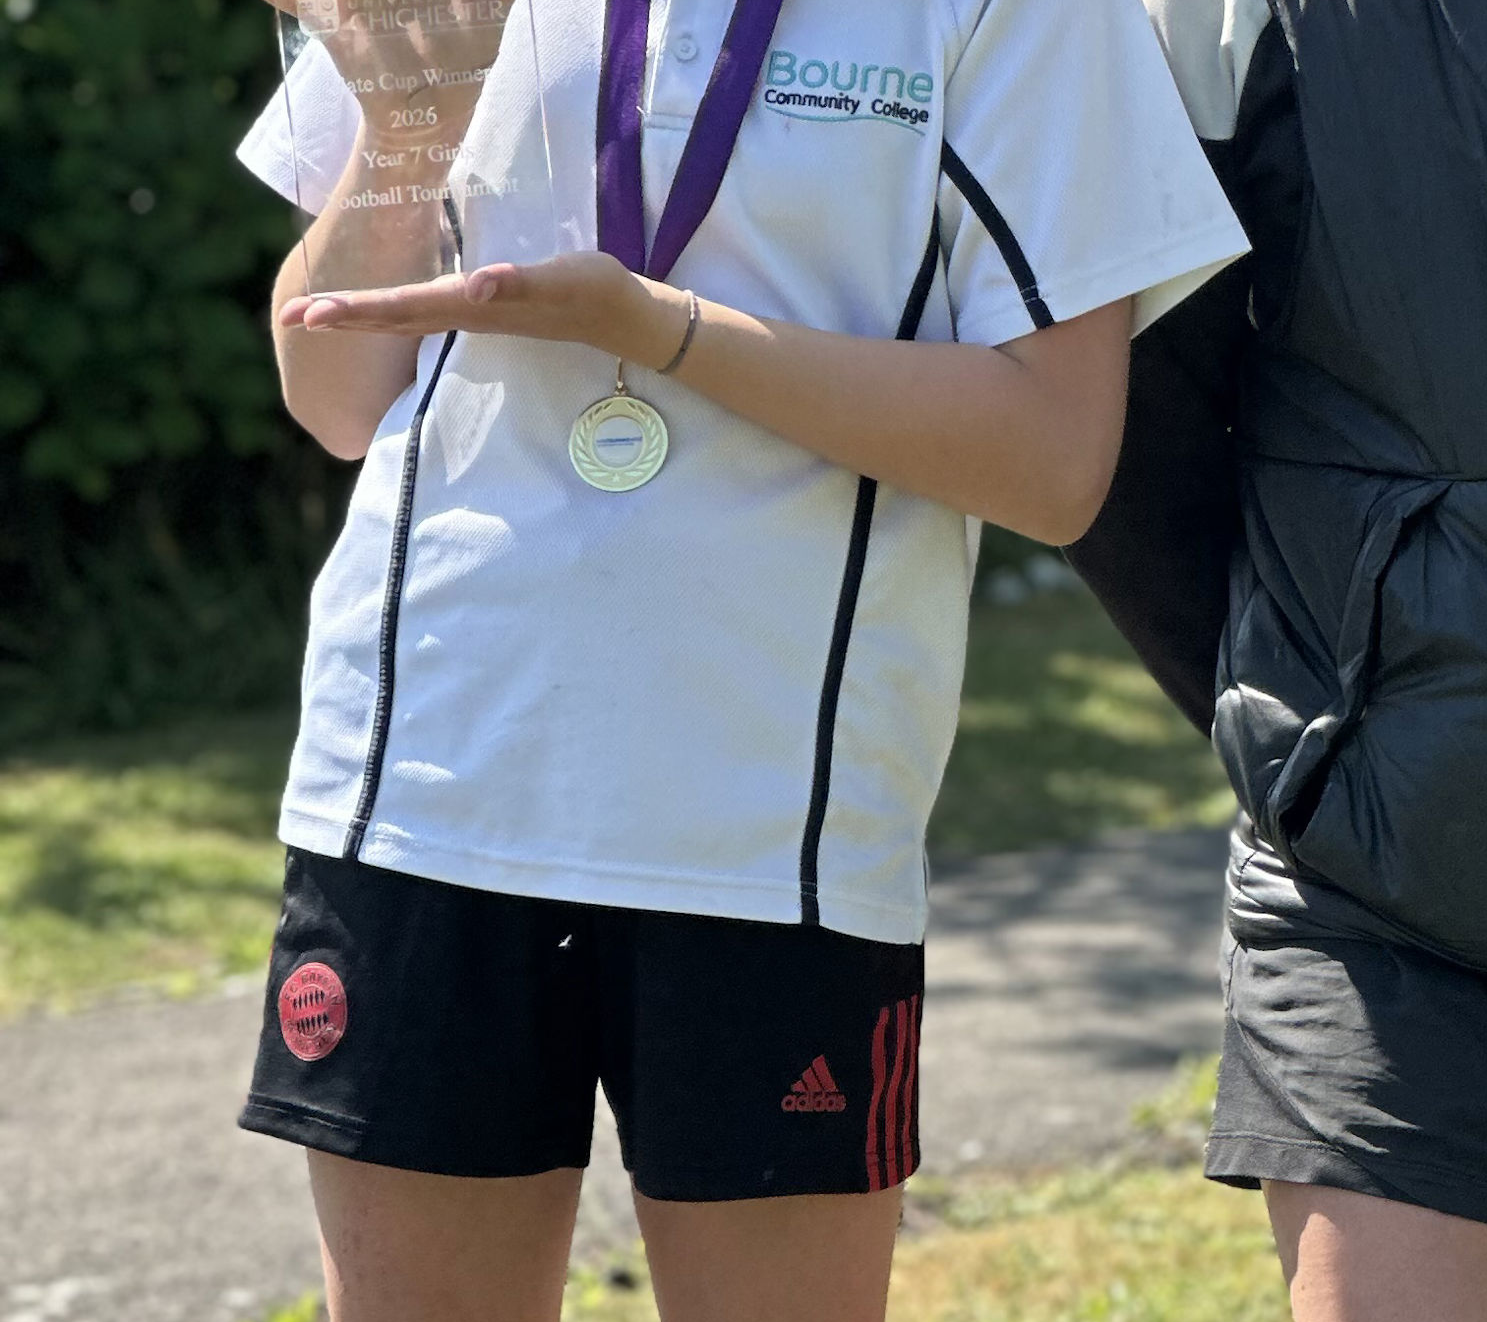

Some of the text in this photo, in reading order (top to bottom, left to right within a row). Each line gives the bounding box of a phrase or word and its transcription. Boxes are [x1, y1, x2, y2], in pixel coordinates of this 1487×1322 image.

[350, 0, 506, 31] CHICHESTER
[378, 72, 418, 93] Cup
[422, 67, 494, 88] Winner
[766, 49, 934, 104] Bourne
[389, 106, 438, 128] 2026
[764, 89, 929, 124] Community College
[361, 150, 405, 169] Year
[409, 147, 421, 165] 7
[330, 178, 519, 210] ootball Touramnt
[781, 1091, 847, 1112] adidas
